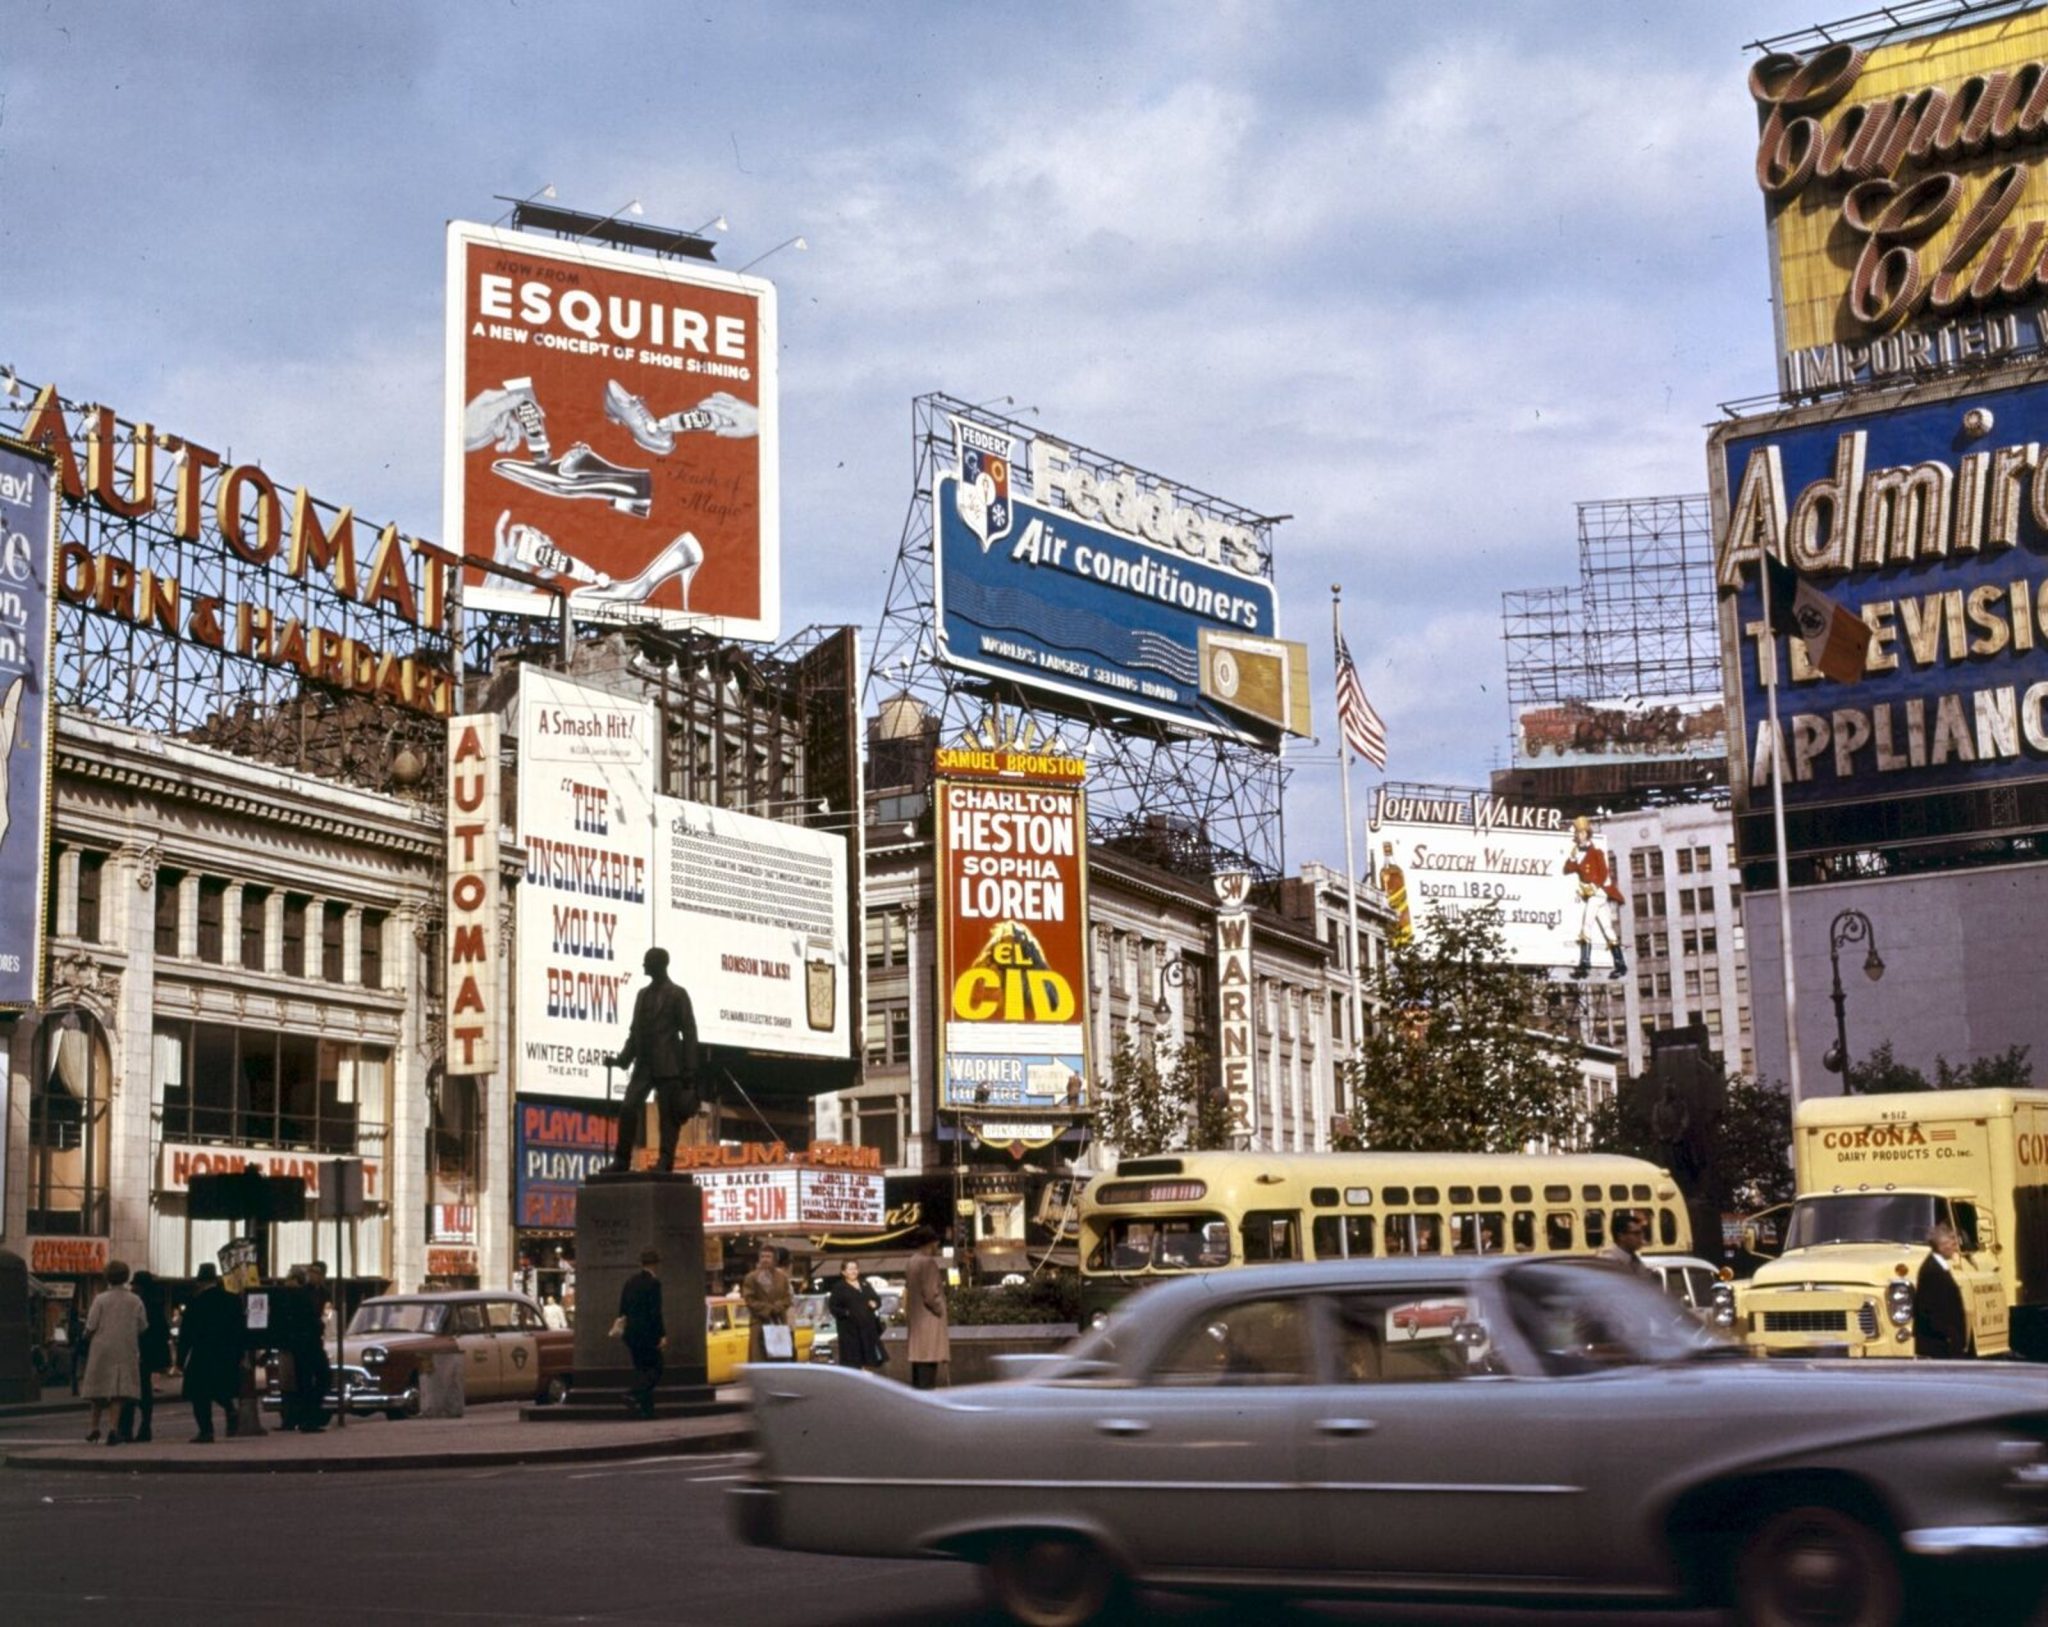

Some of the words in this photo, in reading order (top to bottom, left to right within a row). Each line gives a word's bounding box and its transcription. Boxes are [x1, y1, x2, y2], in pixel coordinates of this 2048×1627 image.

[1845, 163, 2048, 325] Clu
[496, 260, 533, 277] NOW
[537, 267, 580, 286] FROM
[480, 273, 746, 359] ESQUIRE
[472, 322, 485, 337] A
[490, 325, 528, 344] NEW
[533, 332, 609, 358] CONCEPT
[613, 345, 635, 361] OF
[639, 349, 684, 371] SHOE
[686, 358, 751, 381] SHINING
[1788, 312, 2017, 393] IMPORTED
[963, 426, 1008, 457] FEDDERS
[20, 383, 461, 632] AUTOMAT
[1031, 434, 1263, 578] Fedders
[1013, 517, 1066, 568] Air
[1074, 543, 1259, 632] conditioners
[58, 540, 179, 636] ORN
[237, 600, 456, 719] HARDART
[981, 635, 1036, 664] WORLD'S
[1039, 651, 1090, 678] LARGEST
[1093, 666, 1138, 693] SELLING
[539, 709, 549, 735] A
[552, 710, 602, 738] Smash
[606, 713, 635, 739] Hit!
[937, 748, 1000, 771] SAMUEL
[1007, 753, 1086, 777] BRONSTON
[950, 789, 1073, 815] CHARLTON
[1472, 791, 1562, 836] WALKER
[949, 810, 1074, 856] HESTON
[524, 835, 645, 904] UNSINKABLE
[963, 855, 1060, 880] SOPHIA
[452, 725, 486, 1066] AUTOMAT
[961, 877, 1065, 922] LOREN
[1419, 880, 1457, 897] born
[553, 904, 618, 961] MOLLY
[1512, 908, 1562, 930] strong!
[721, 954, 758, 977] RONSON
[993, 943, 1033, 966] EL
[953, 967, 1076, 1022] CID
[1219, 919, 1250, 1131] WARNER
[526, 1041, 573, 1065] WINTER
[547, 1065, 589, 1078] THEATRE
[948, 1058, 1023, 1083] WARNER
[1823, 1127, 1927, 1150] CORONA
[807, 1140, 881, 1169] FORUM
[1837, 1151, 1867, 1163] DAIRY
[1872, 1149, 1930, 1162] PRODUCTS
[1936, 1147, 1956, 1159] CO.
[726, 1172, 770, 1186] BAKER
[721, 1188, 739, 1205] TO
[744, 1186, 787, 1222] SUN
[719, 1207, 742, 1223] THE
